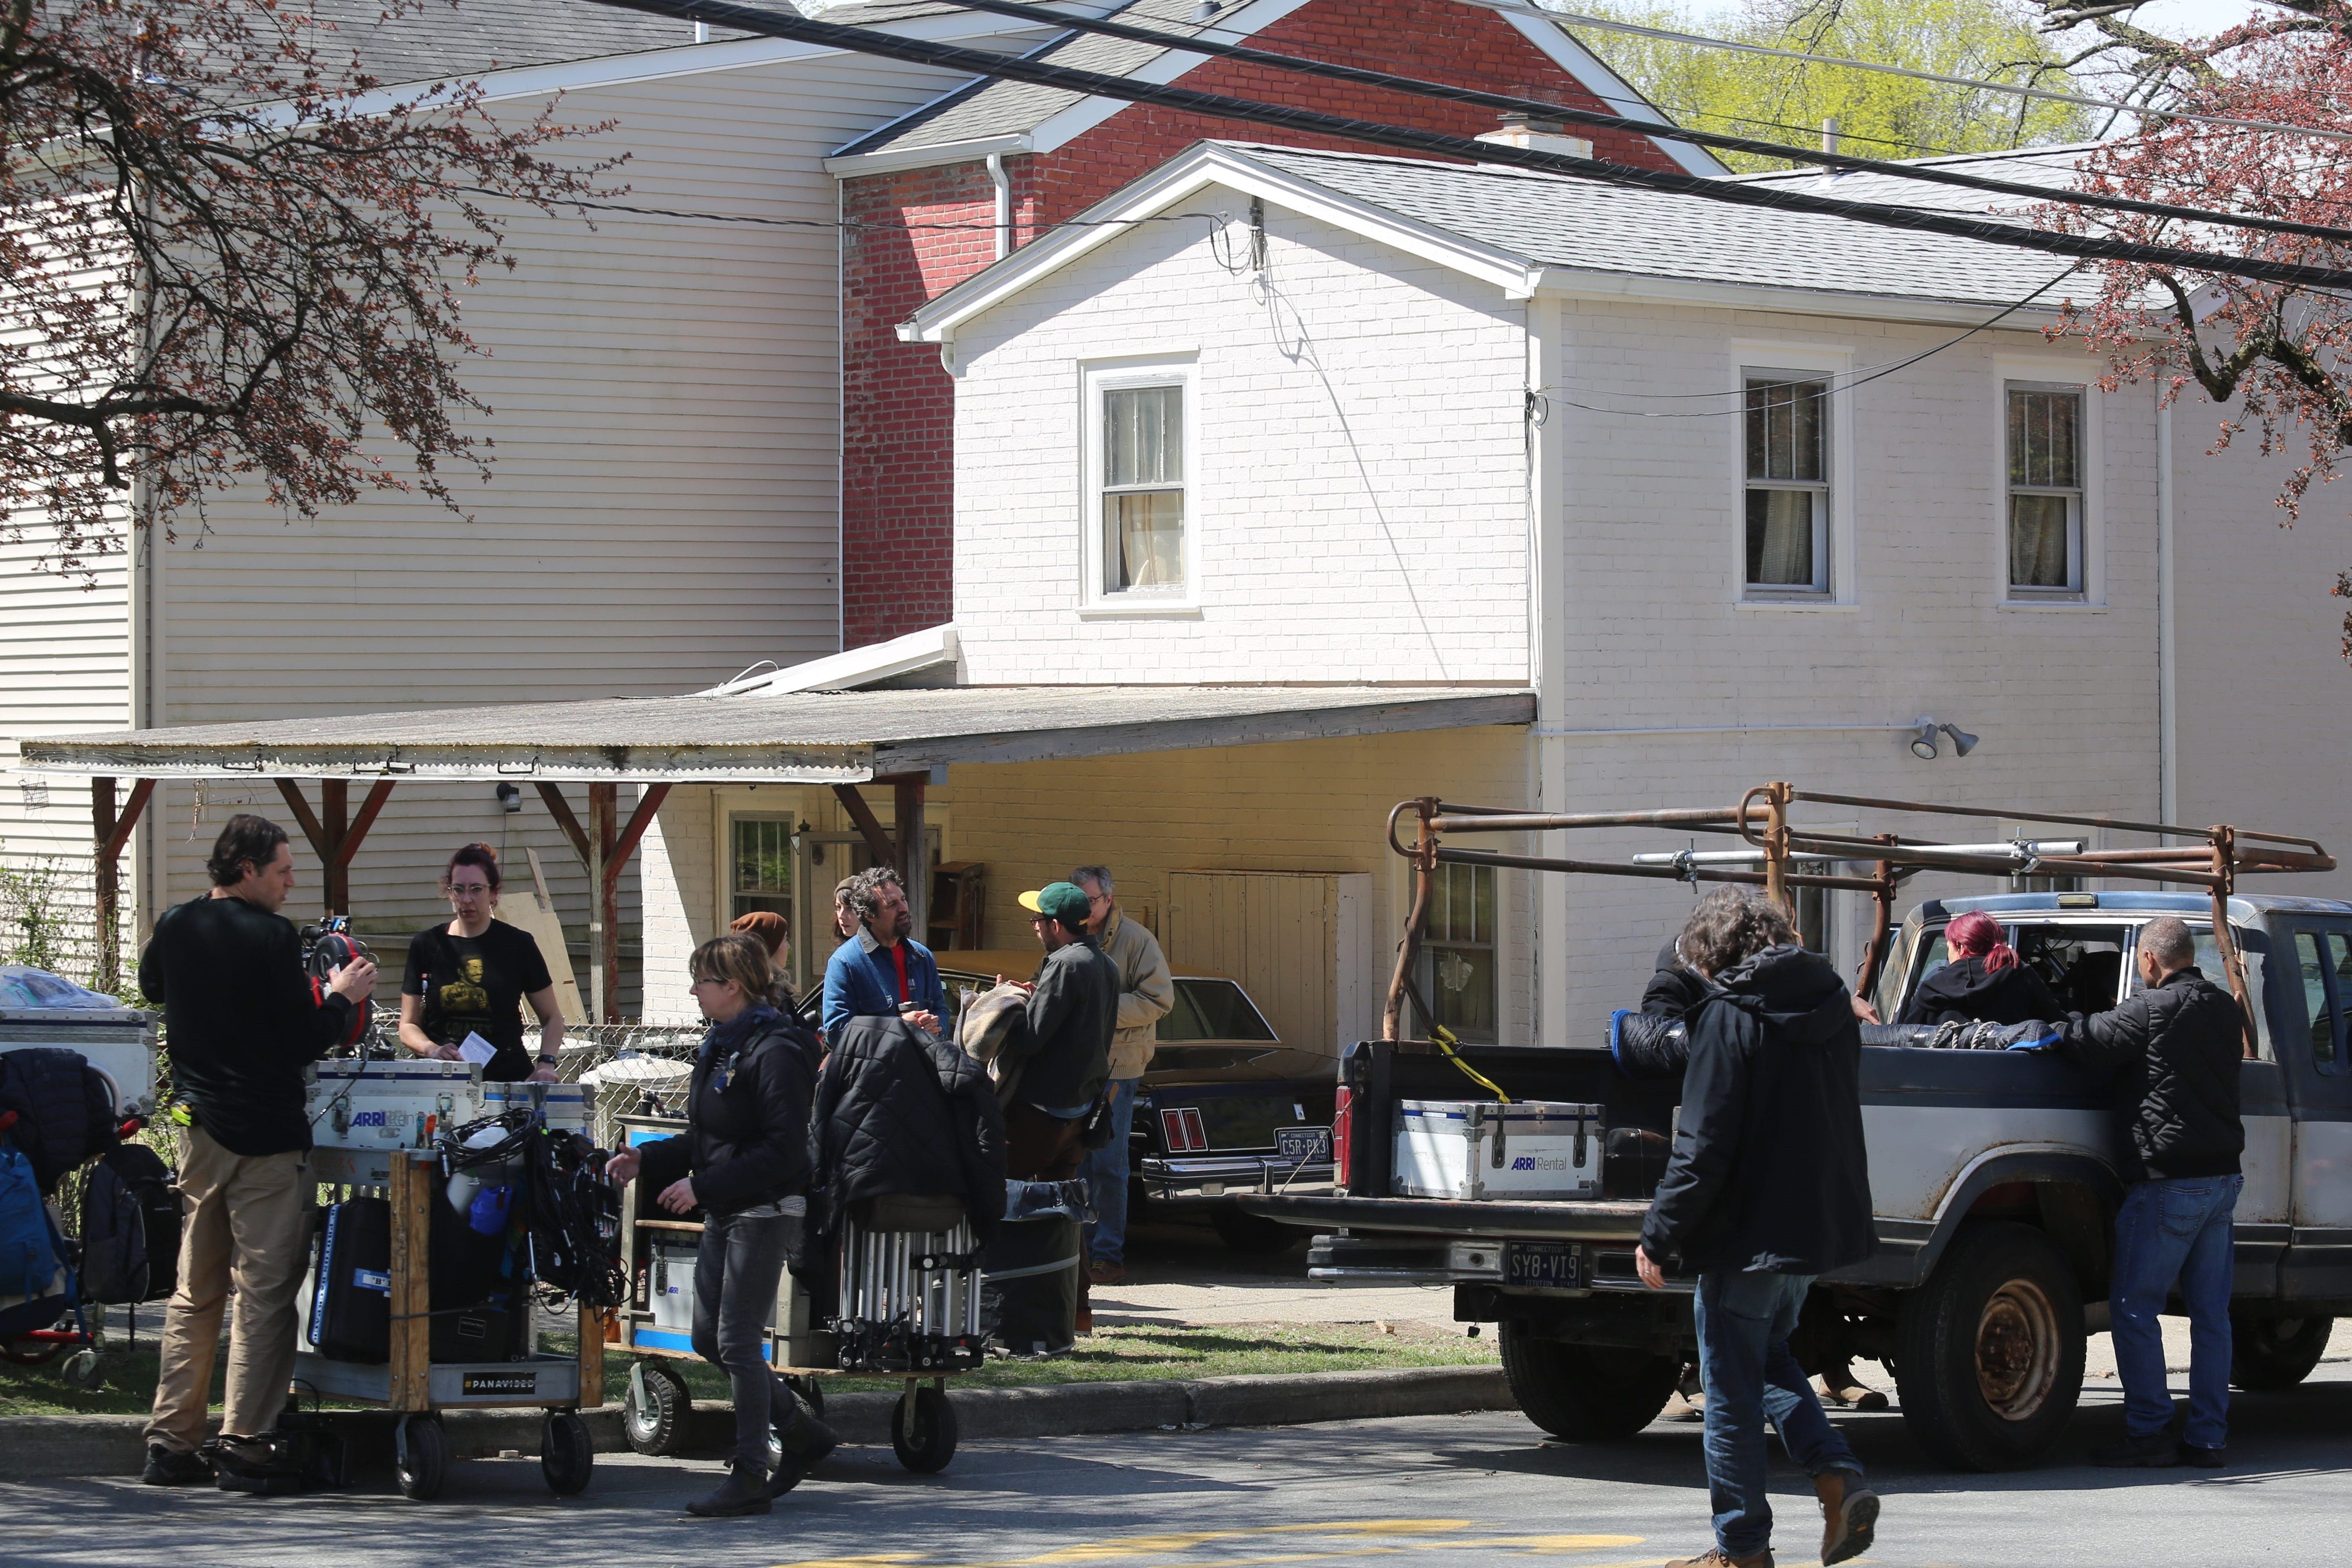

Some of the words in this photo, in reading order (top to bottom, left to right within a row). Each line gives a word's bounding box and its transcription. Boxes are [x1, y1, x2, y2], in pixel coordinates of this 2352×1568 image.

[349, 1112, 386, 1127] ARRI
[1511, 1157, 1535, 1170] ARRI
[1537, 1157, 1566, 1170] Rental
